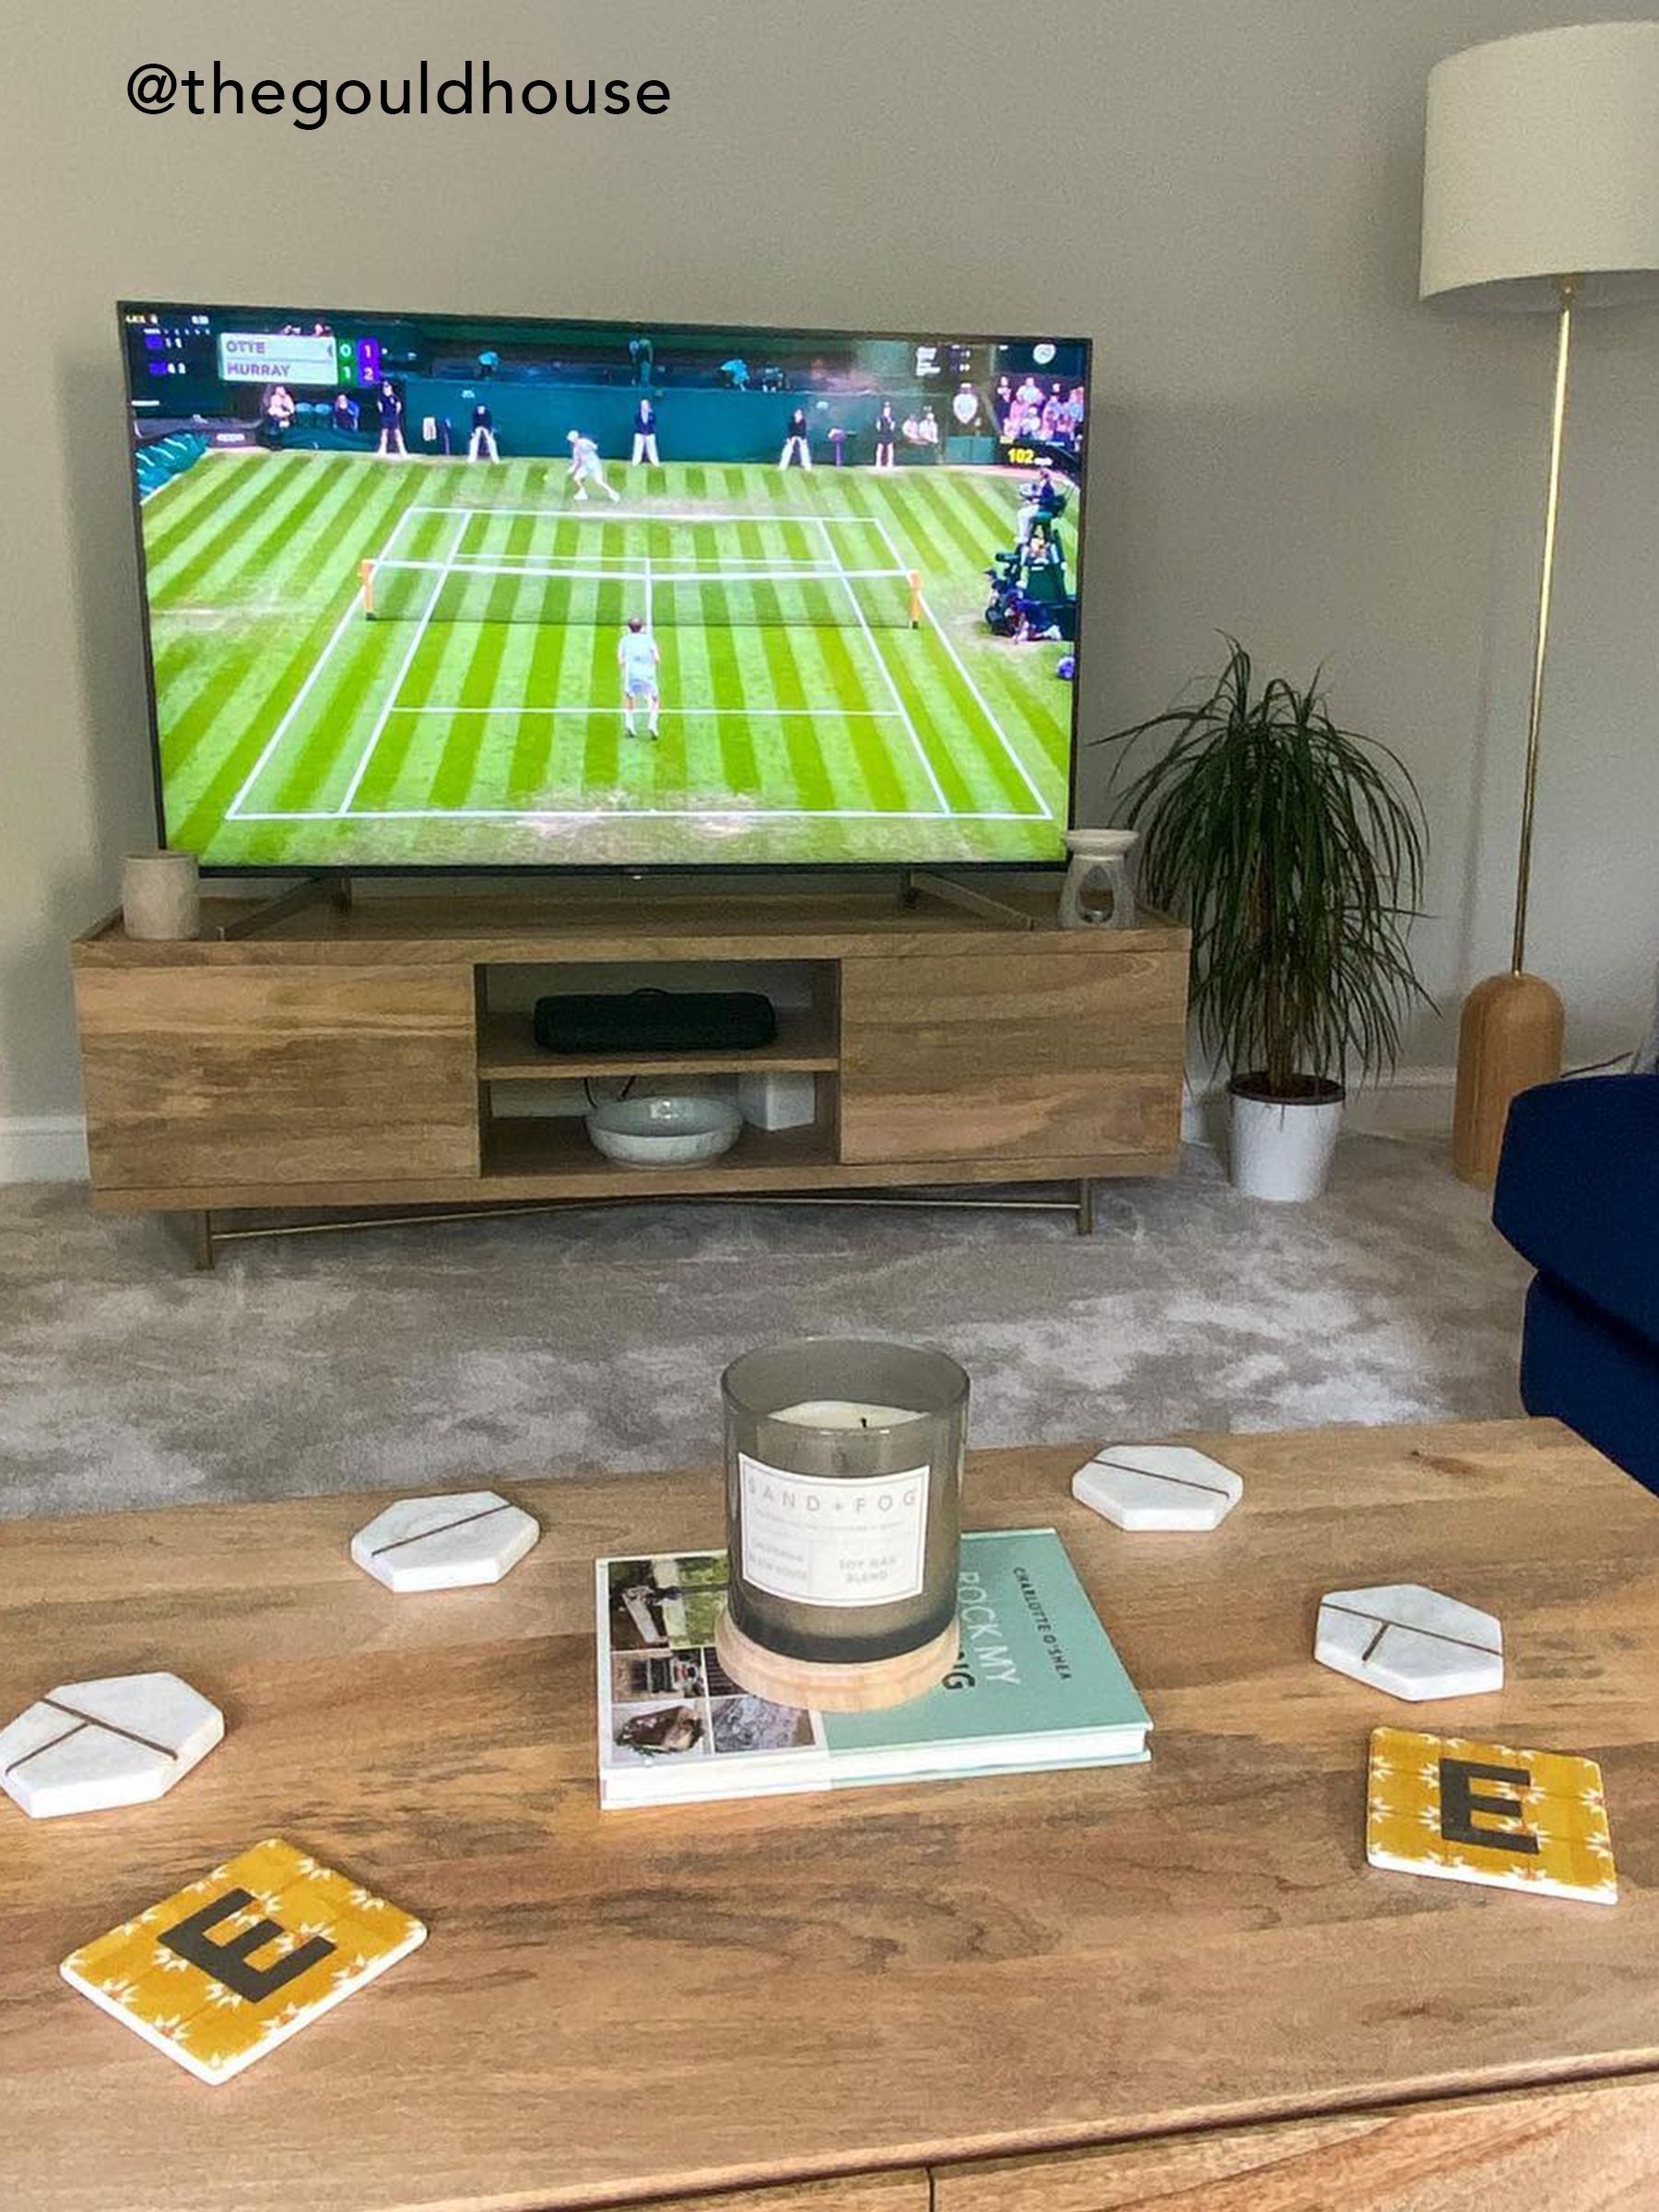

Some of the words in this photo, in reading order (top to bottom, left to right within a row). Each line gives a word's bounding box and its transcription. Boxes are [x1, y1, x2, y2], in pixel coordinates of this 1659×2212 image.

[225, 340, 265, 354] OTTE
[339, 344, 352, 358] 0
[226, 362, 291, 378] MURRAY
[342, 365, 351, 380] 1
[363, 367, 374, 381] 2
[1007, 448, 1035, 464] 102
[748, 1475, 821, 1512] SAND
[855, 1488, 918, 1513] FOG
[957, 1571, 1004, 1641] ROCK
[1013, 1566, 1051, 1632] CHARLOTTE
[973, 1644, 1021, 1686] MY
[1438, 1757, 1540, 1855] E
[157, 1887, 338, 2004] E
